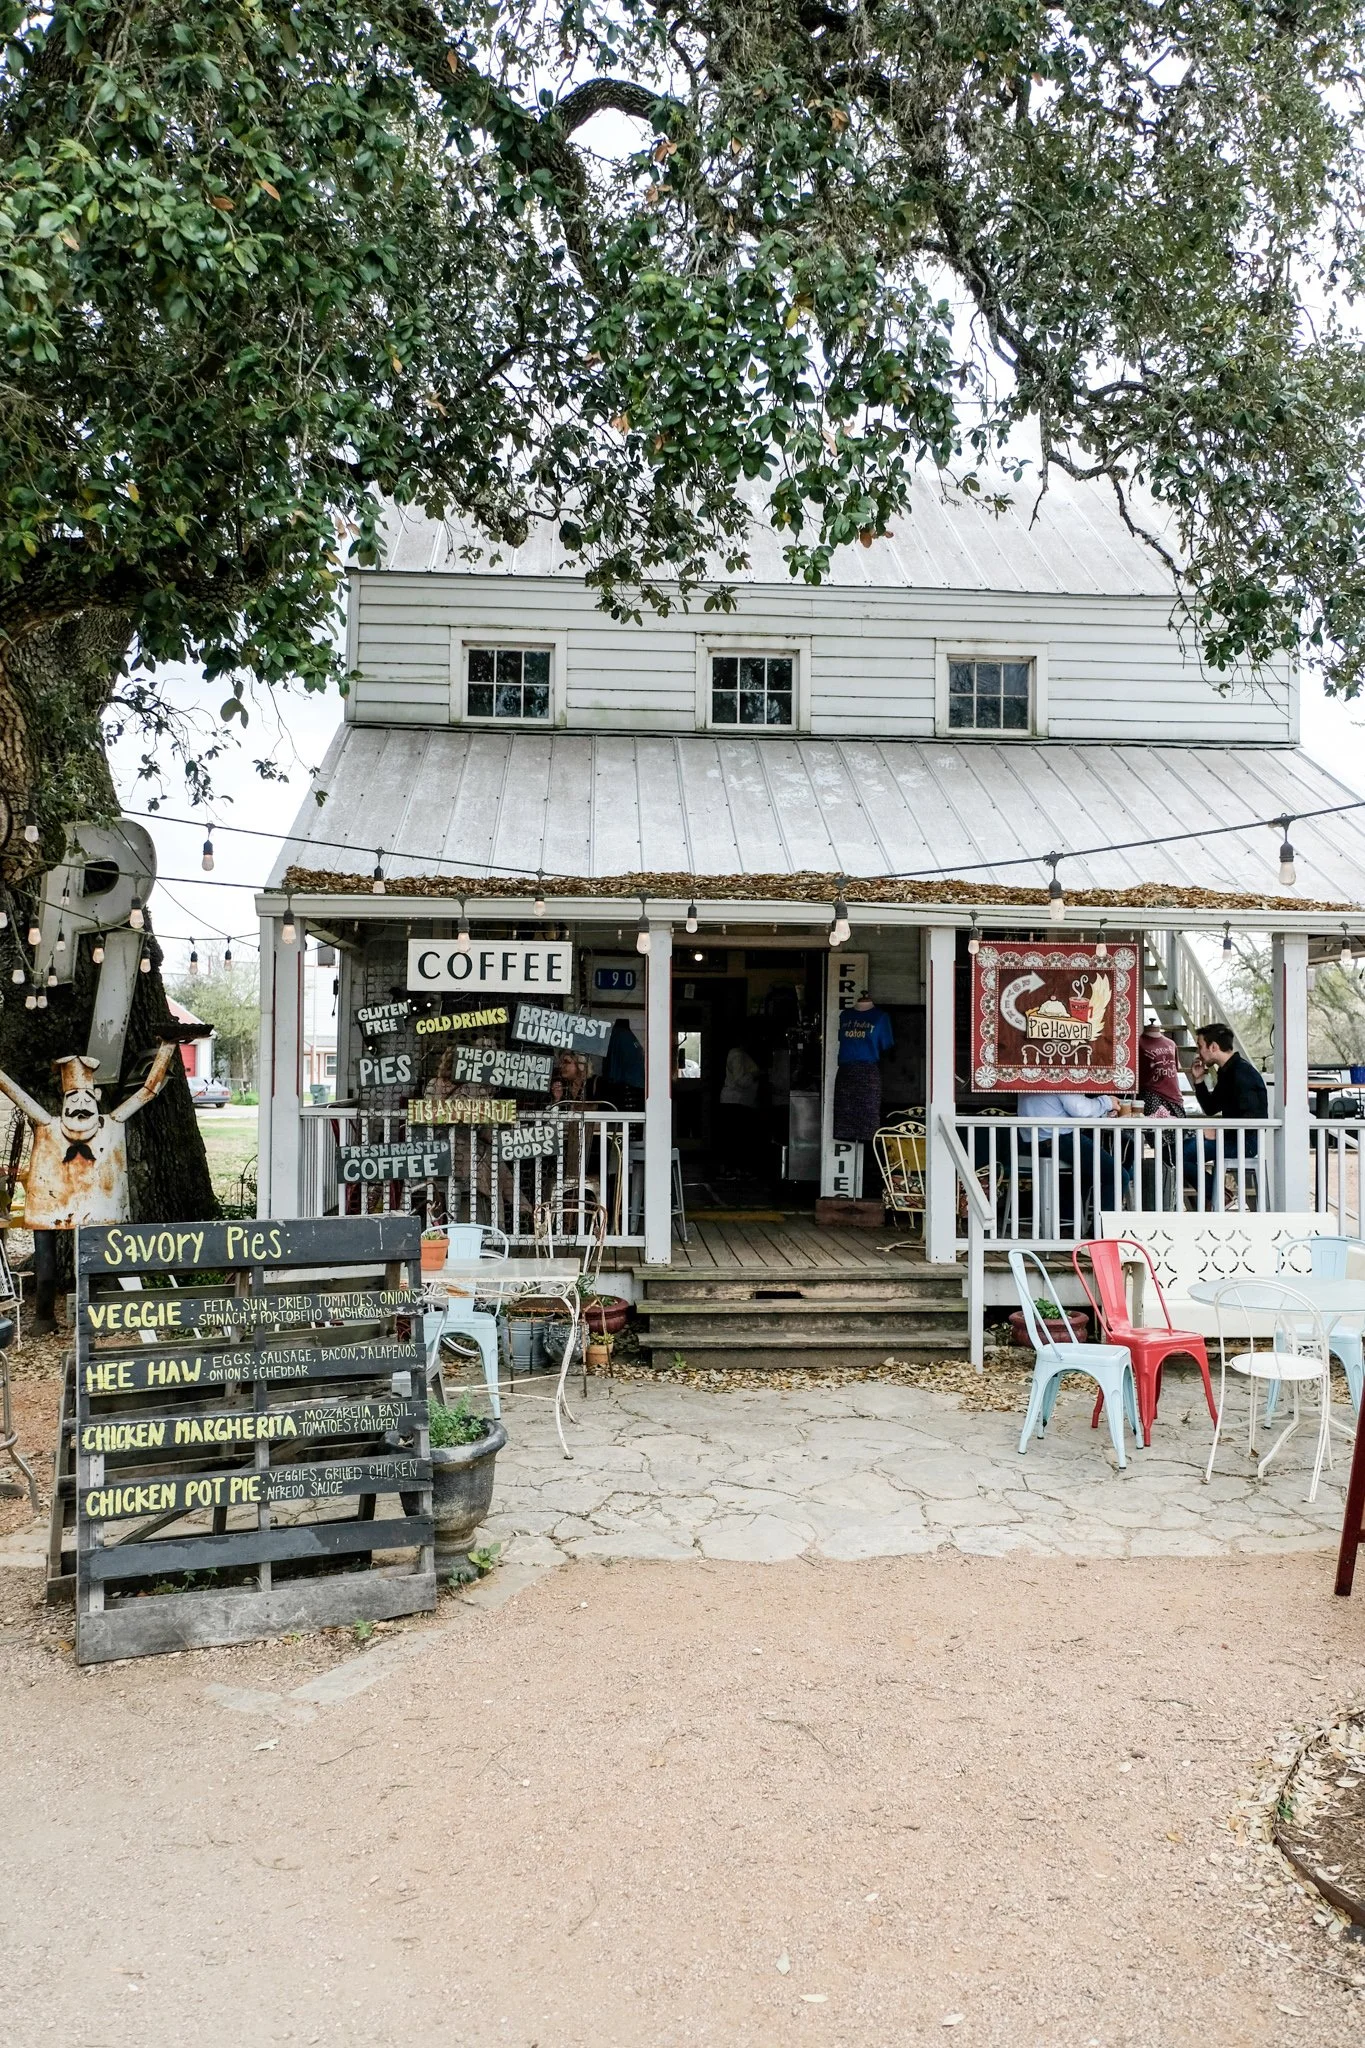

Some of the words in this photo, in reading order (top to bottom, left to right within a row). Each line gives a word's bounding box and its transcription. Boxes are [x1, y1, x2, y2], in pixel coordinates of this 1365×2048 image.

[417, 951, 562, 982] COFFEE
[357, 1001, 409, 1021] GLUTEN
[365, 1019, 398, 1035] FREE
[416, 1016, 452, 1035] COLD
[516, 1023, 574, 1049] LUNCH
[456, 1047, 482, 1061] THE
[435, 1100, 446, 1117] A
[500, 1126, 554, 1147] BAKED
[340, 1143, 389, 1159] FRESH
[501, 1140, 554, 1161] GOODS
[343, 1154, 439, 1182] COFFEE
[834, 1143, 852, 1198] PIE
[242, 1296, 312, 1312] SUN-DRIED
[86, 1361, 135, 1392] HEE
[209, 1366, 250, 1381] ONIONS
[259, 1365, 310, 1379] CHEDDAR
[82, 1422, 165, 1451] CHICKEN
[299, 1418, 351, 1436] TOMATOES
[360, 1417, 399, 1432] CHICKEN
[369, 1460, 418, 1481] CHICKEN
[86, 1482, 176, 1517] CHICKEN
[185, 1477, 226, 1507] POT
[310, 1481, 343, 1496] SAUCE
